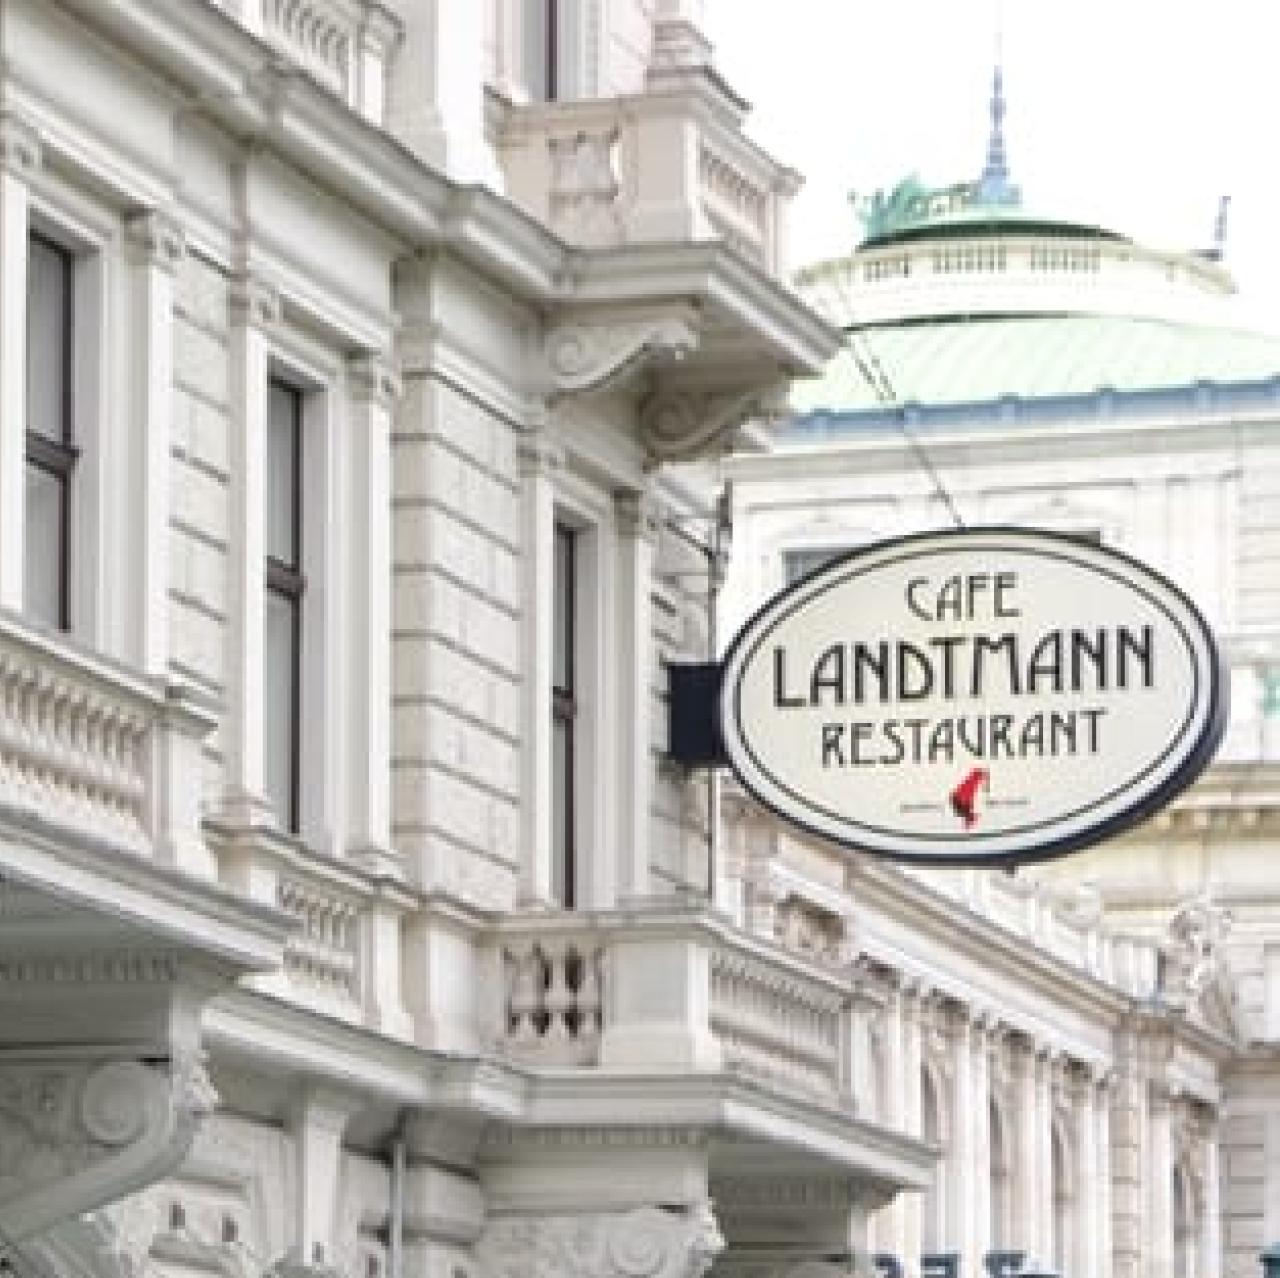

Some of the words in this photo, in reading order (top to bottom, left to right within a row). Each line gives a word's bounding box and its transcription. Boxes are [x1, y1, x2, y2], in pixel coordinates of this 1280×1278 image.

[906, 571, 1021, 622] CAFE
[773, 624, 1155, 707] LANDTMANN
[821, 707, 1106, 768] RESTAURANT
